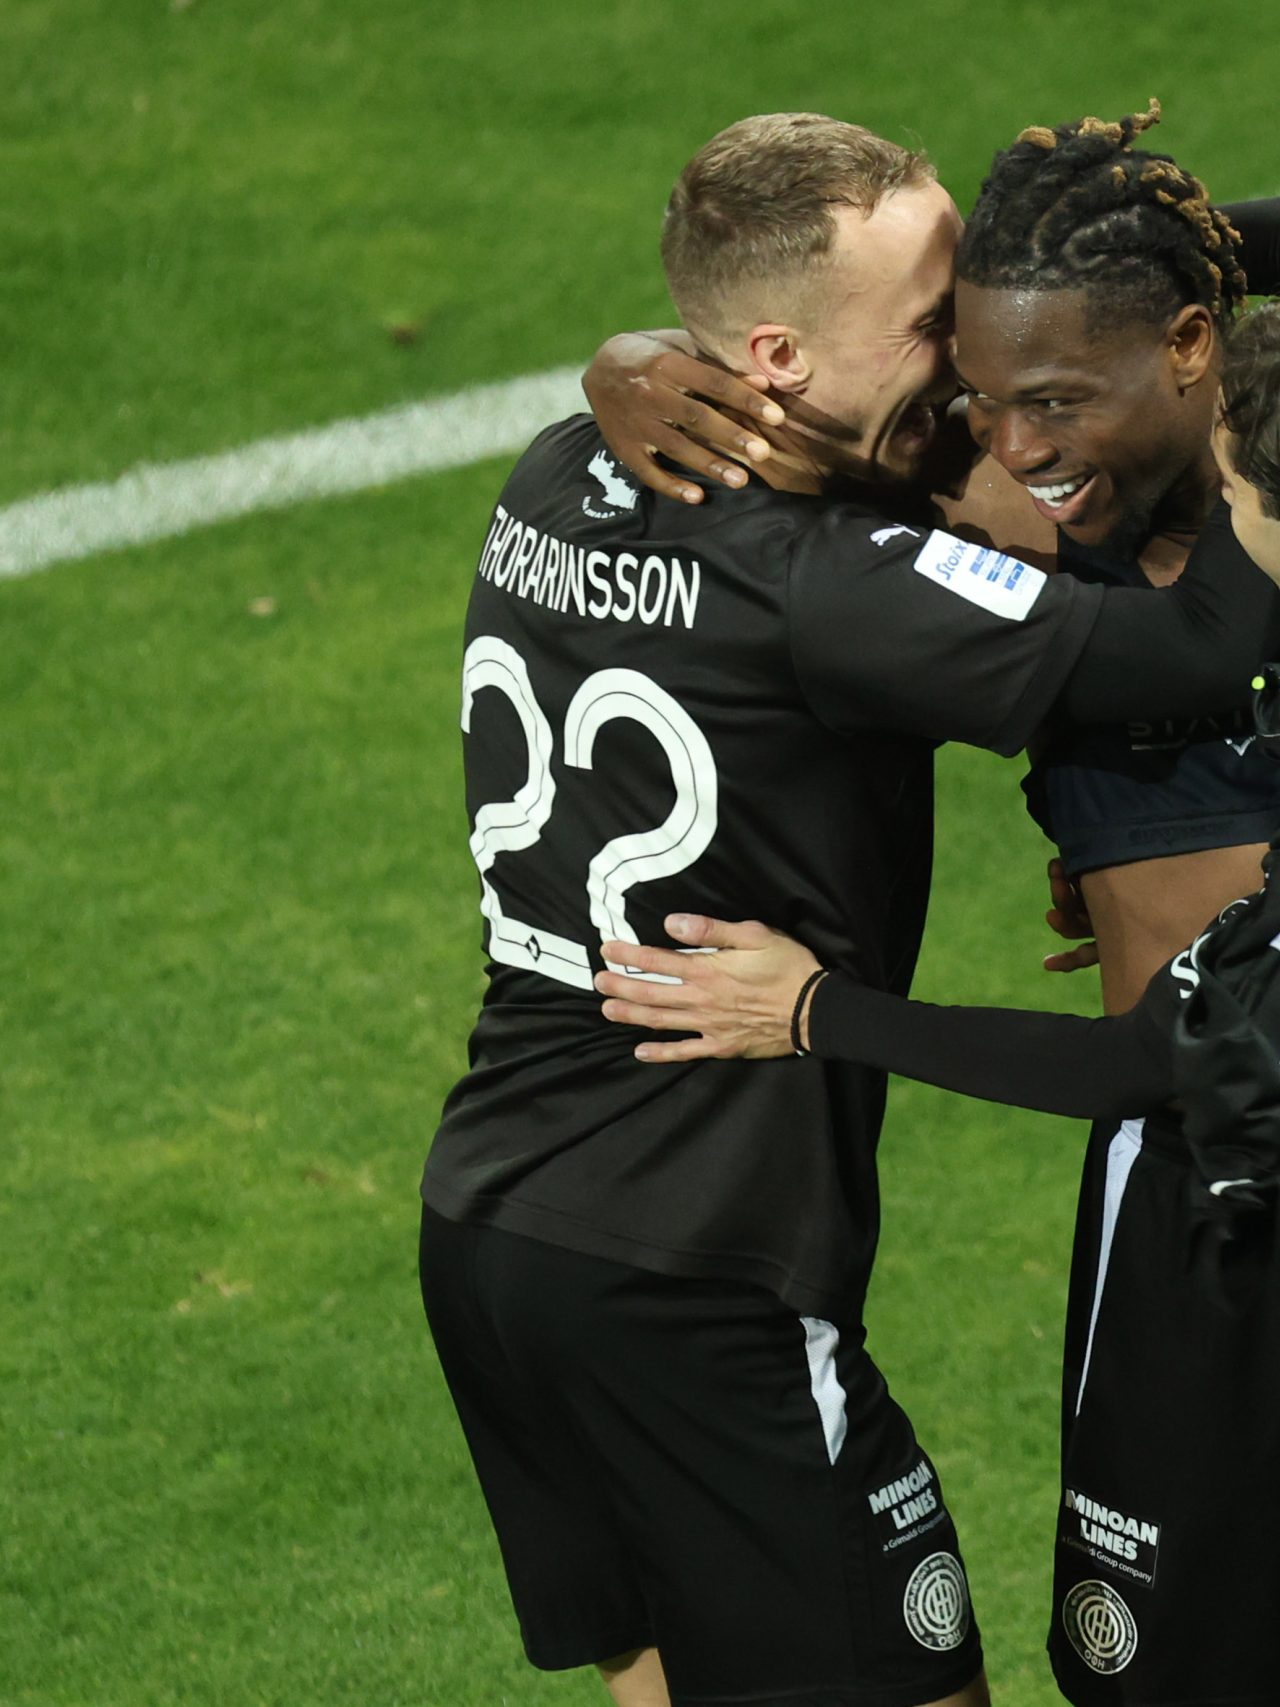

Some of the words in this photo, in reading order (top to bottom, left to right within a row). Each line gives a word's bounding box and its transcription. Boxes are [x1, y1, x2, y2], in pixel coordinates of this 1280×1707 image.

[478, 504, 701, 629] THORARINSSON
[935, 540, 969, 581] Stoix
[461, 635, 718, 992] 22
[867, 1459, 933, 1515] MINOAN
[891, 1487, 937, 1530] LINES
[1065, 1488, 1159, 1546] MINOAN
[1080, 1518, 1138, 1561] LINES
